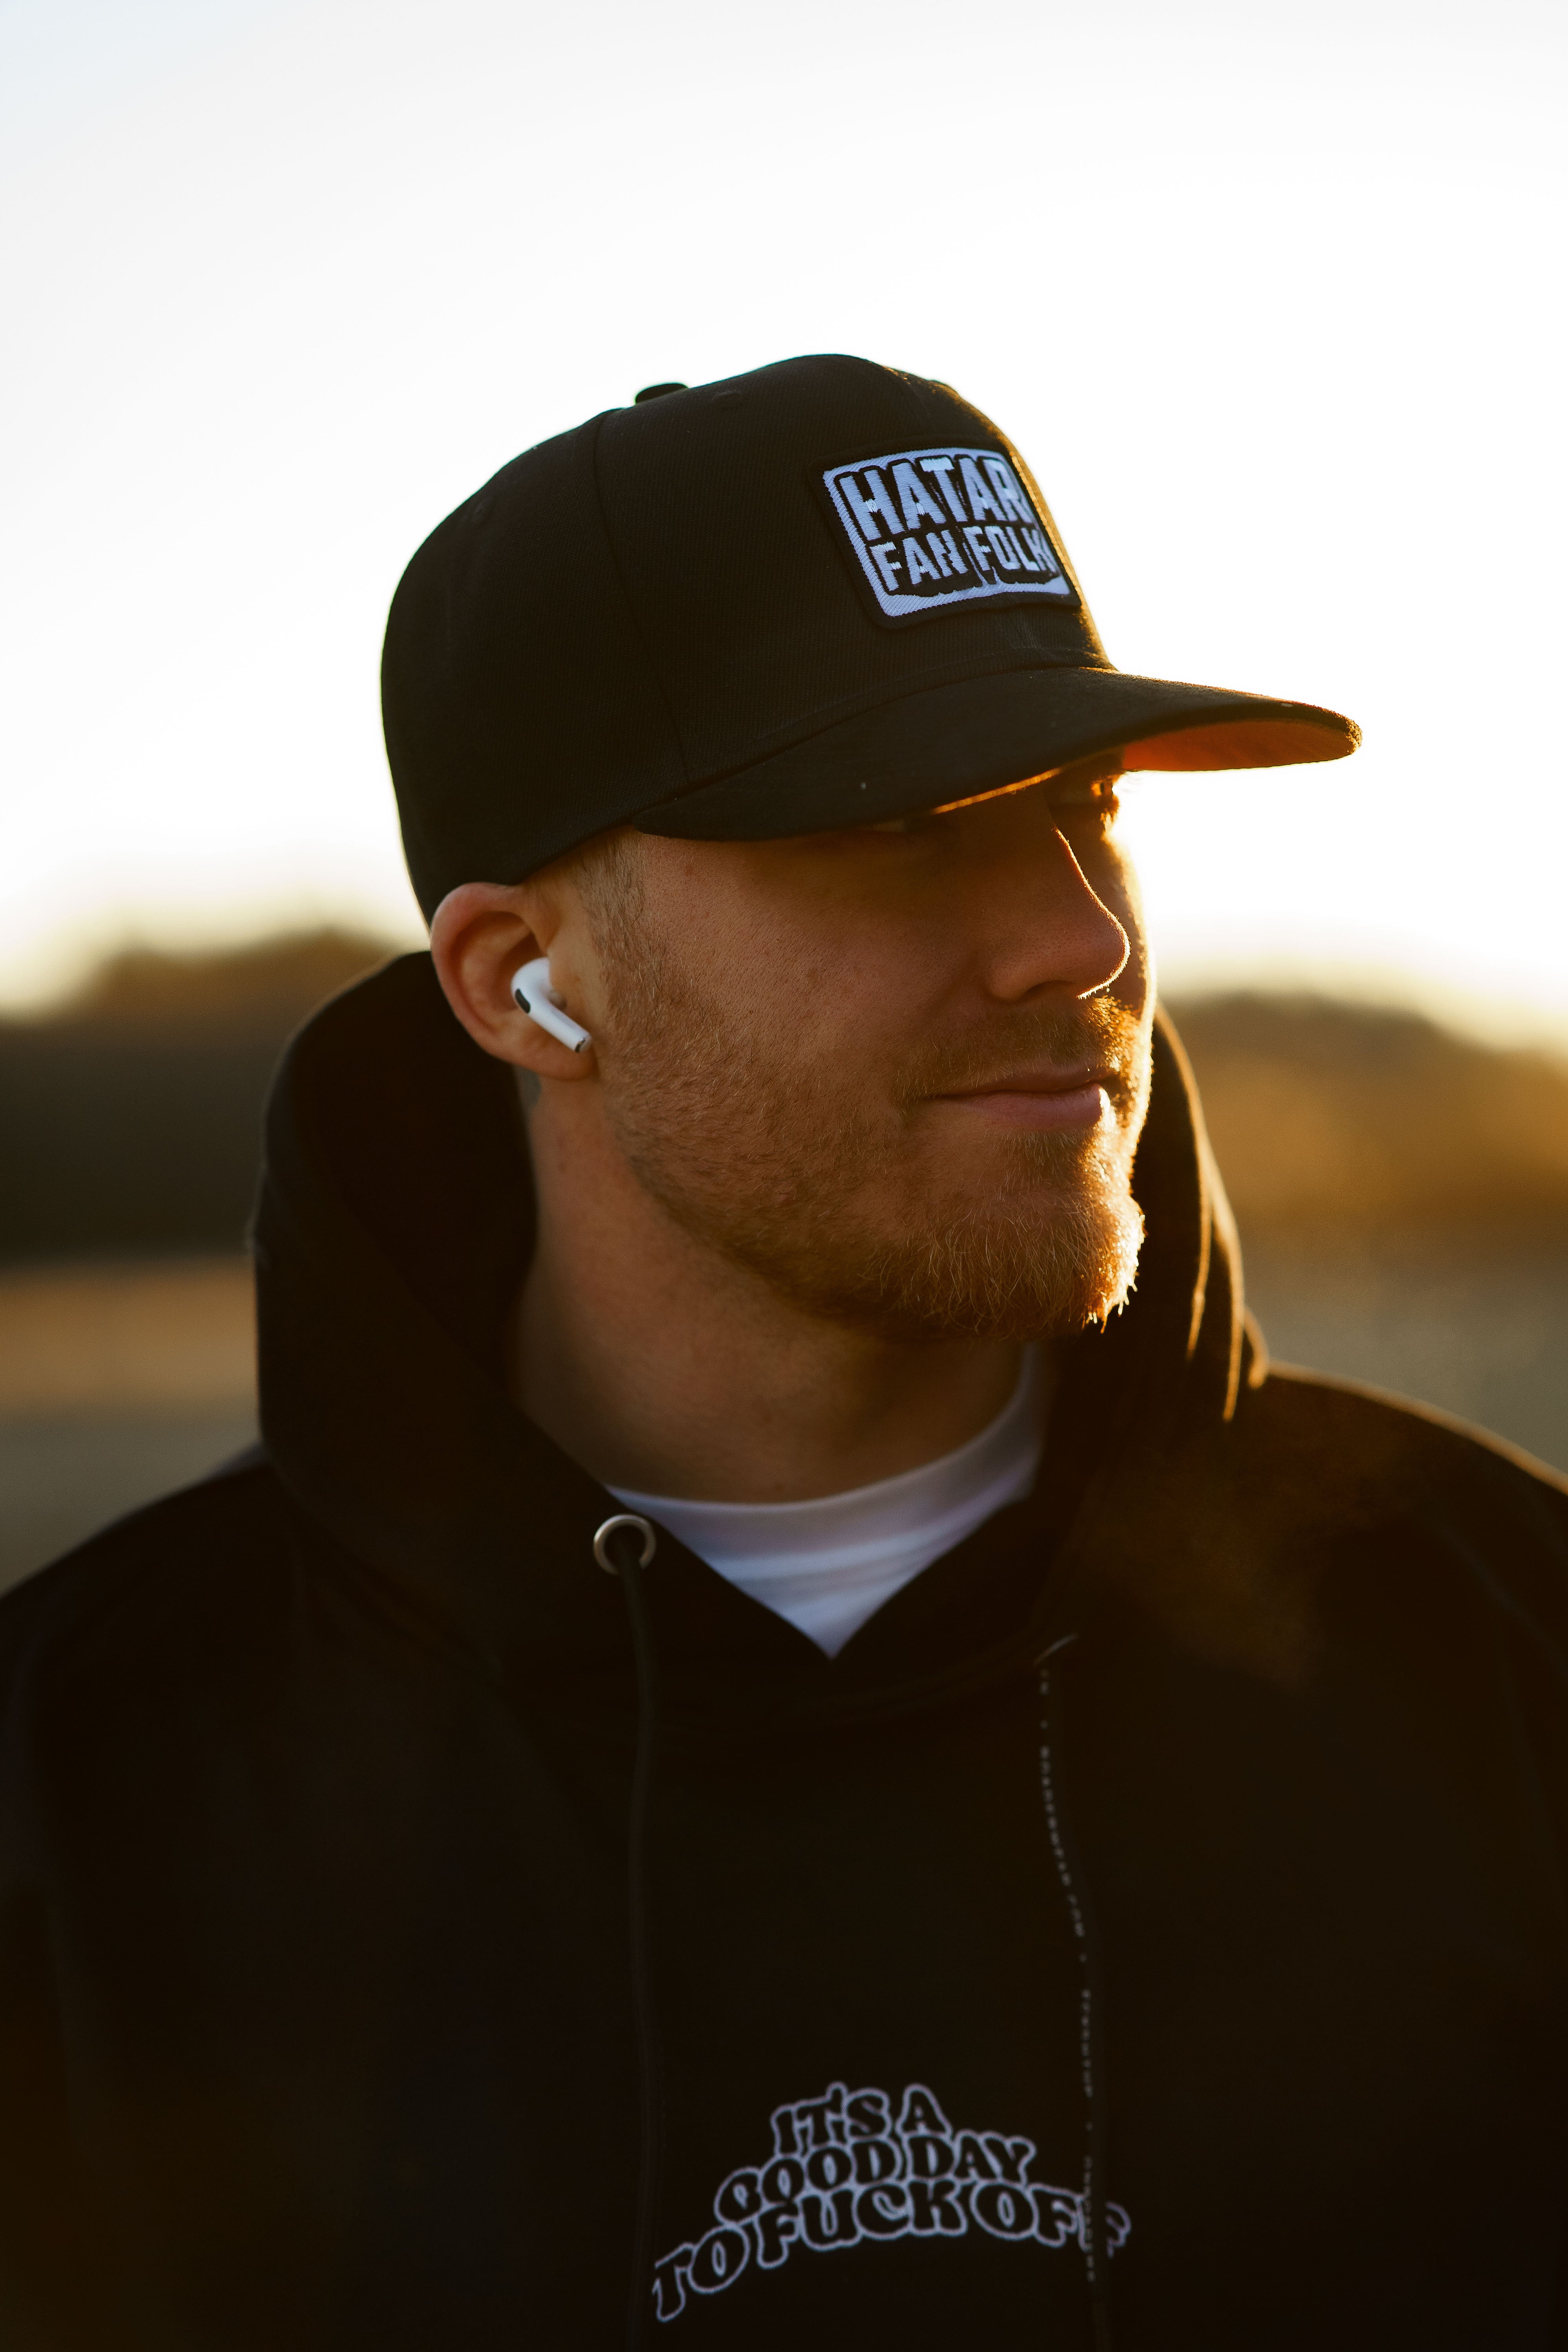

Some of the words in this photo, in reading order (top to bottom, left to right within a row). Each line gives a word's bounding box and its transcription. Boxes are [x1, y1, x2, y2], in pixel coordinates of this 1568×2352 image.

[838, 456, 1035, 541] HATAR
[869, 529, 968, 591] FAN
[962, 525, 1058, 574] FOLK
[895, 2083, 954, 2143] A
[713, 2133, 904, 2228] GOOD
[902, 2130, 1037, 2186] DAY
[652, 2223, 752, 2323] TO
[751, 2178, 968, 2270] FUCK
